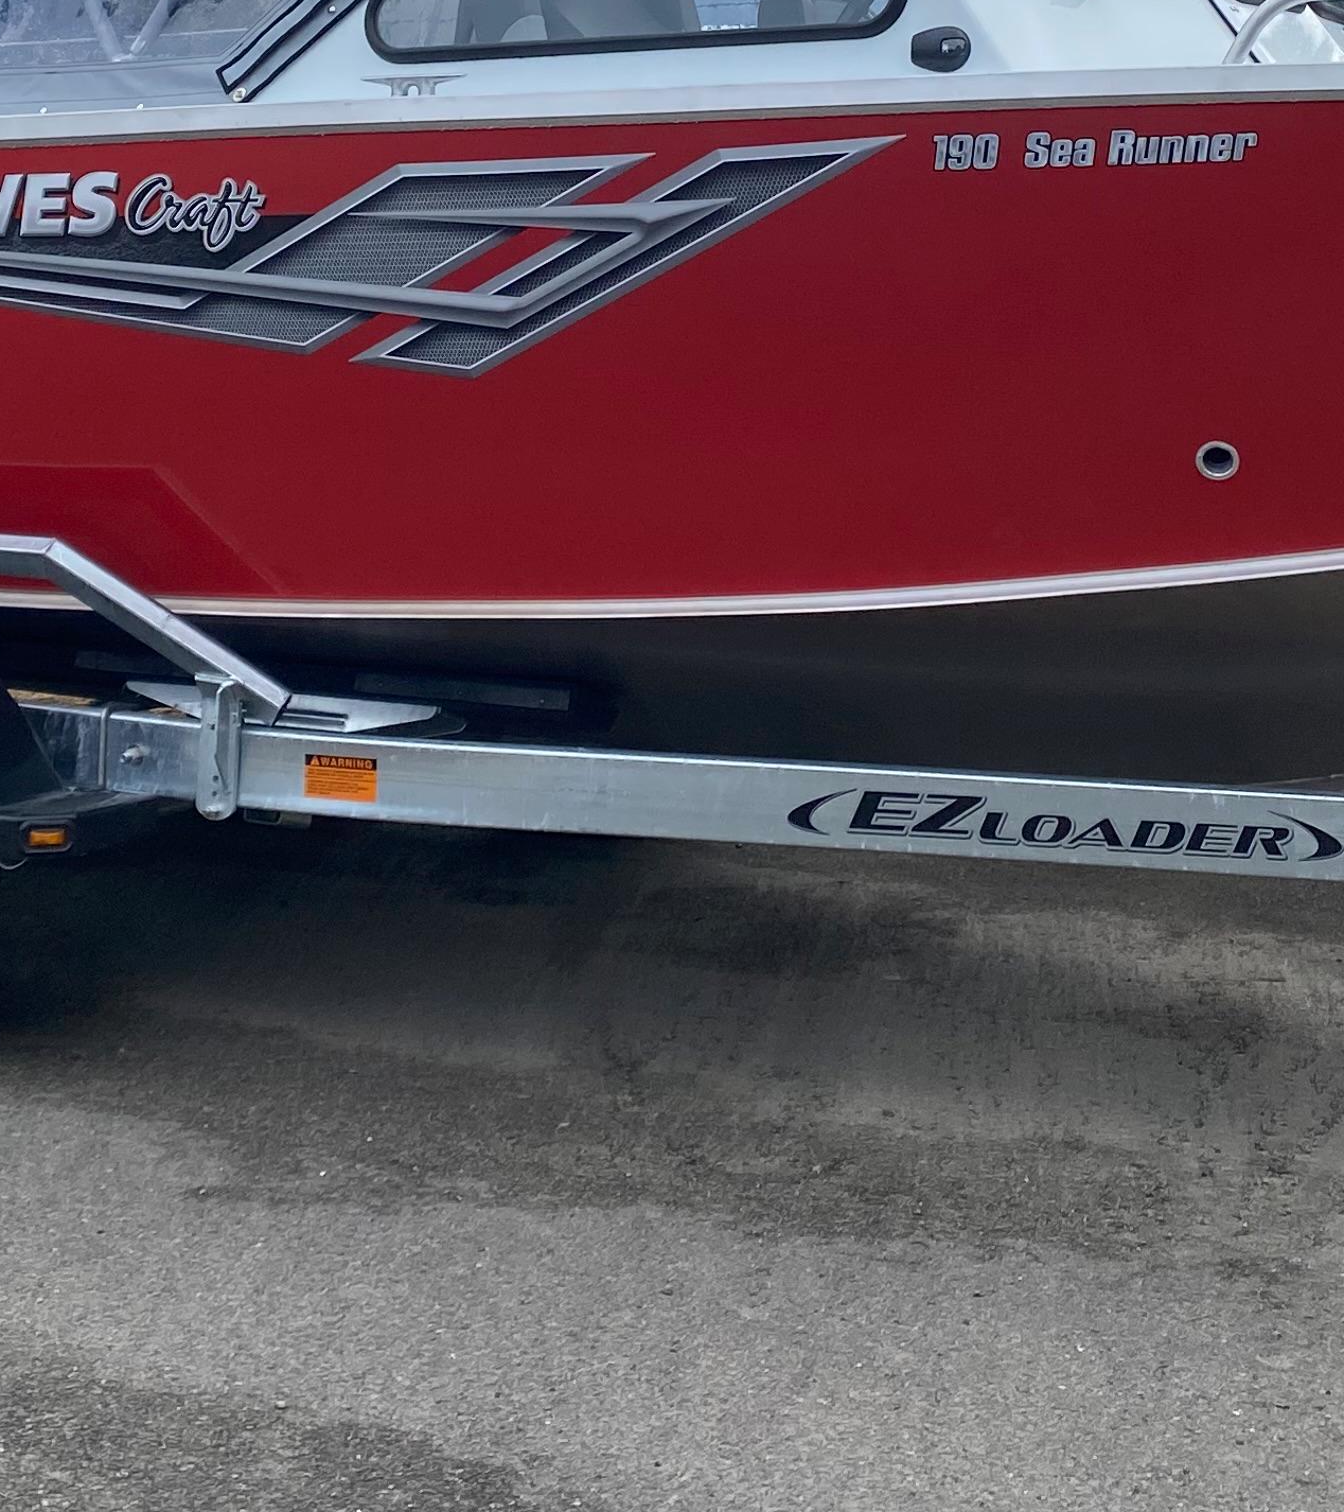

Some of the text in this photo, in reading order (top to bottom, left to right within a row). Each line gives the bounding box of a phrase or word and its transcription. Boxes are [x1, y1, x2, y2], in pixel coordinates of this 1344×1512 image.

[932, 128, 1258, 171] 190 Sea Runner
[123, 173, 266, 253] Craft
[320, 757, 373, 770] WARNING
